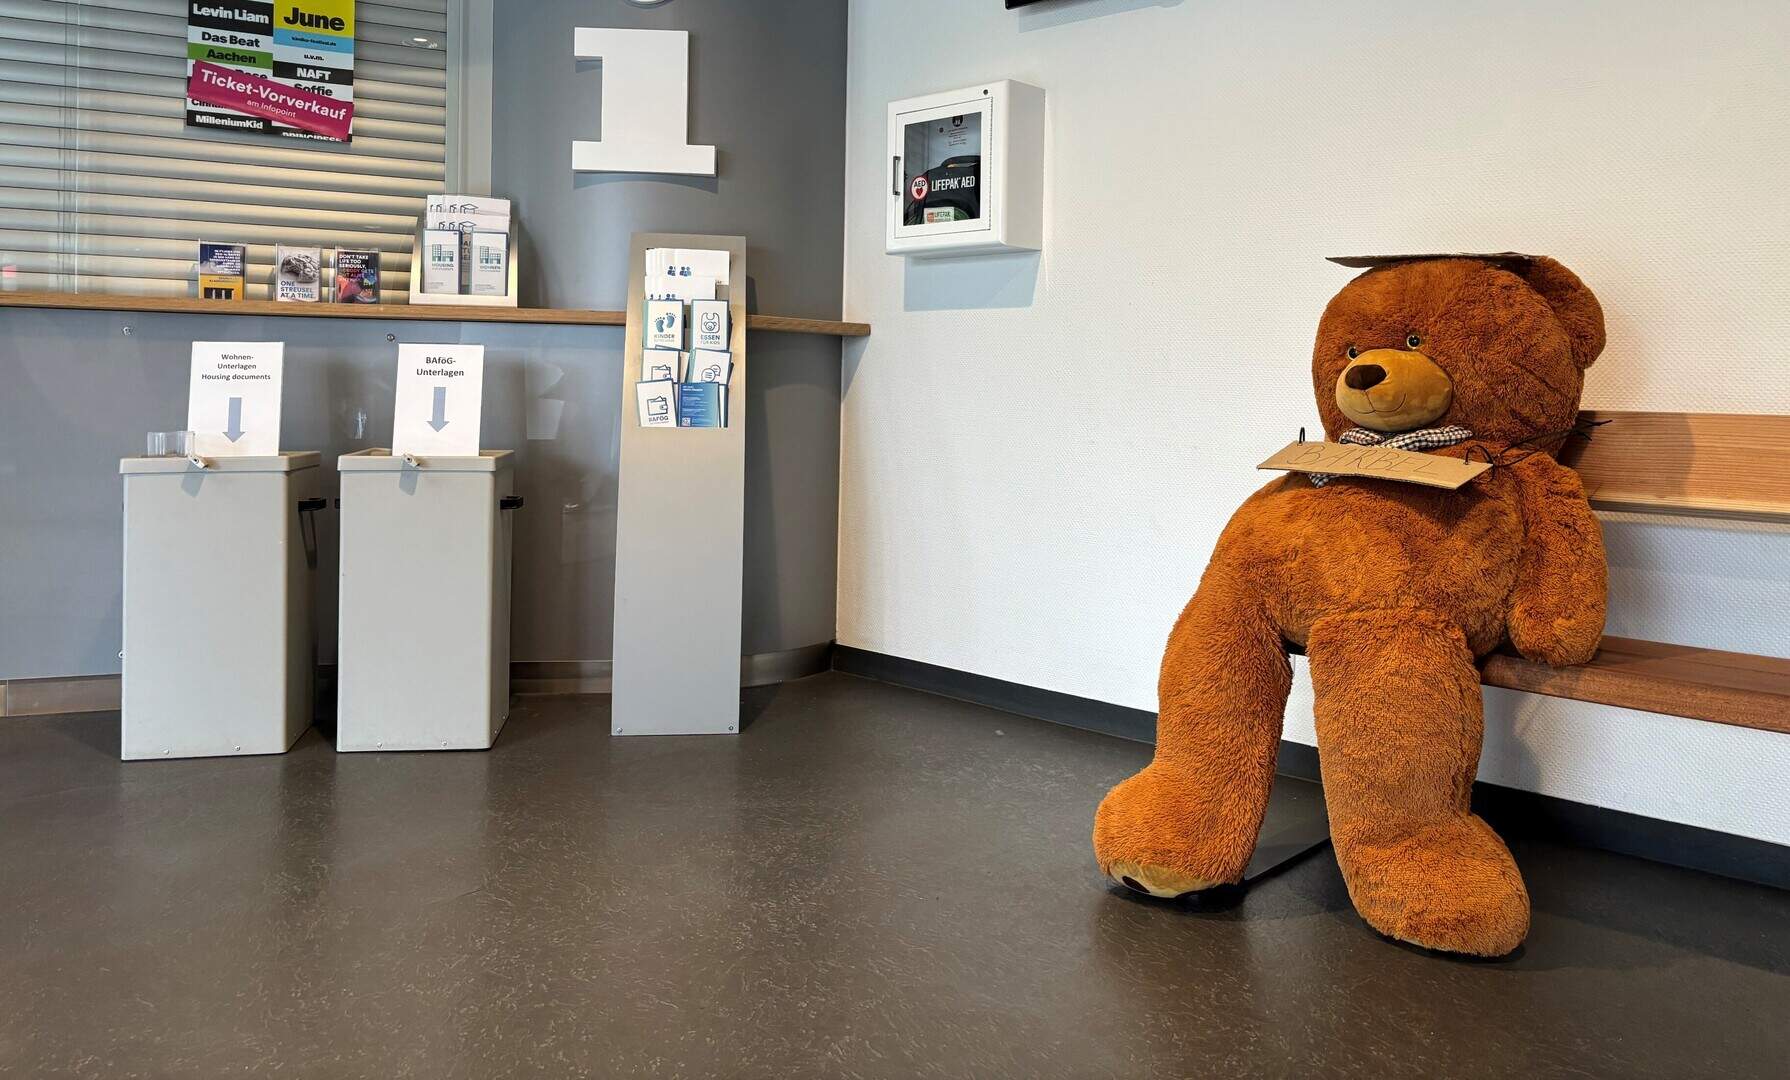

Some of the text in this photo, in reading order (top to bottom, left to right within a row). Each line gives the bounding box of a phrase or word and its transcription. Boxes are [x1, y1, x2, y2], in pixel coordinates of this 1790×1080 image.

[193, 3, 269, 24] Levin Liam
[284, 7, 345, 31] June
[201, 32, 260, 48] Das Beat
[206, 49, 256, 64] Aachen
[296, 67, 331, 80] NAFT
[201, 68, 347, 120] Ticket-Vorverkauf
[247, 100, 296, 118] am Infopoint
[195, 115, 263, 129] MilleniumKid
[914, 179, 926, 188] AED
[961, 175, 976, 188] AED
[425, 356, 456, 364] BAföG-
[201, 373, 231, 381] Housing
[416, 368, 464, 378] Unterlagen
